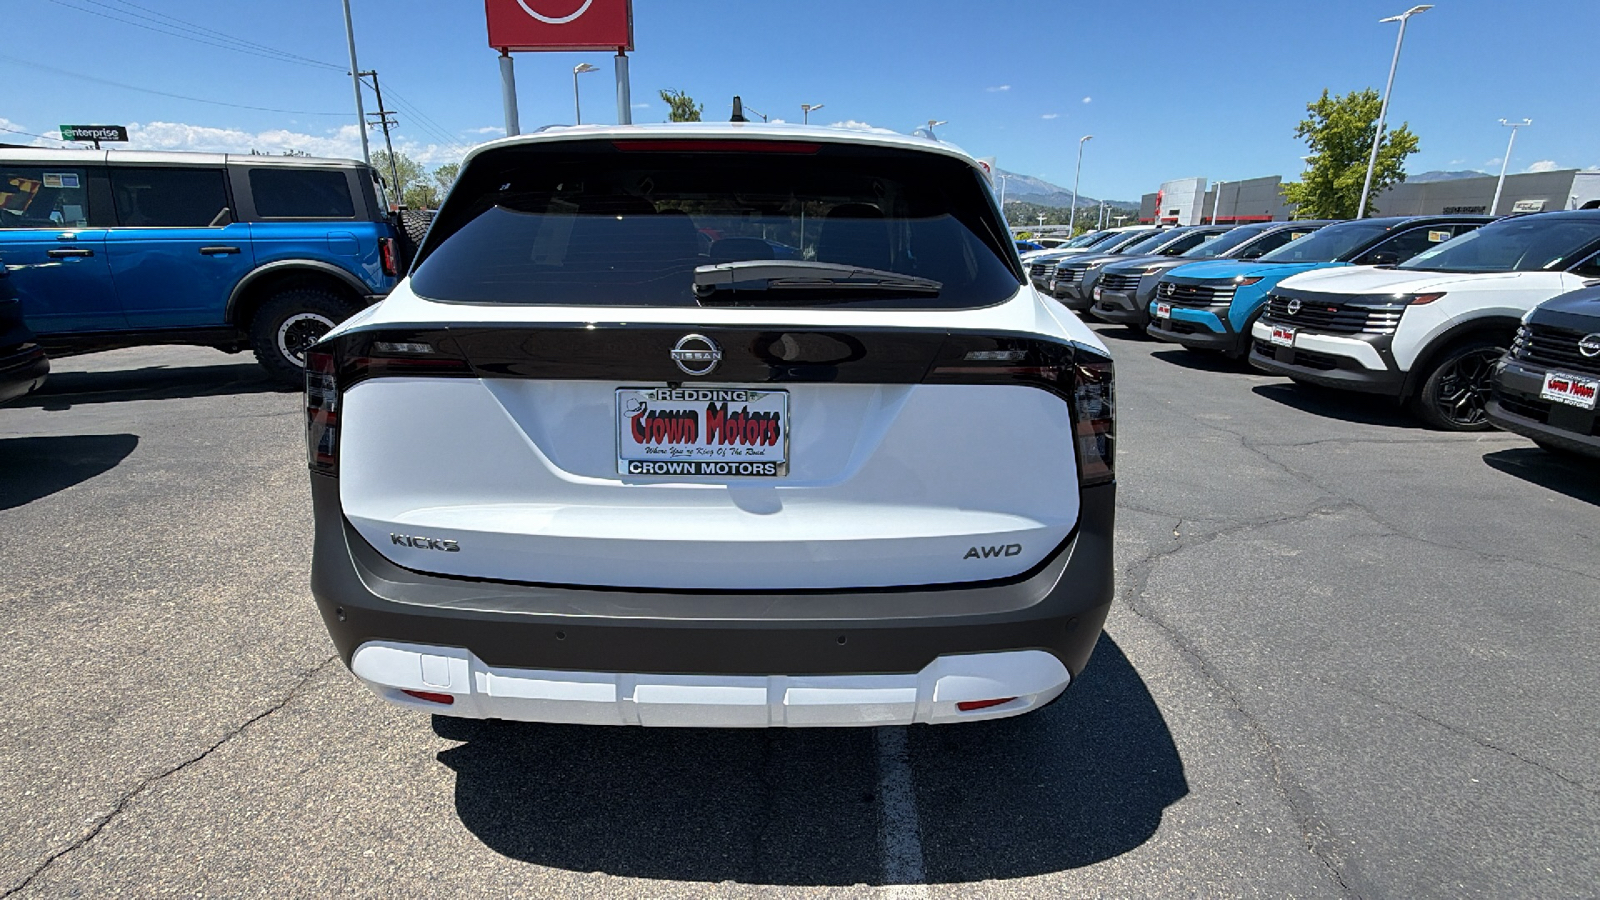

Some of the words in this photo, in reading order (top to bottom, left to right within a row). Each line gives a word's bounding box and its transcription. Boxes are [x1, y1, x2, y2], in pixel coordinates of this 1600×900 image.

[64, 128, 118, 138] enterprise
[657, 390, 746, 401] REDDING
[631, 402, 698, 445] Crown
[706, 402, 780, 446] Motors
[670, 446, 694, 458] You're
[696, 447, 714, 457] King
[716, 448, 727, 457] Of
[730, 448, 742, 456] The
[630, 462, 696, 474] CROWN
[702, 462, 776, 474] MOTORS
[390, 532, 460, 552] KICKS
[963, 544, 1022, 560] AWD
